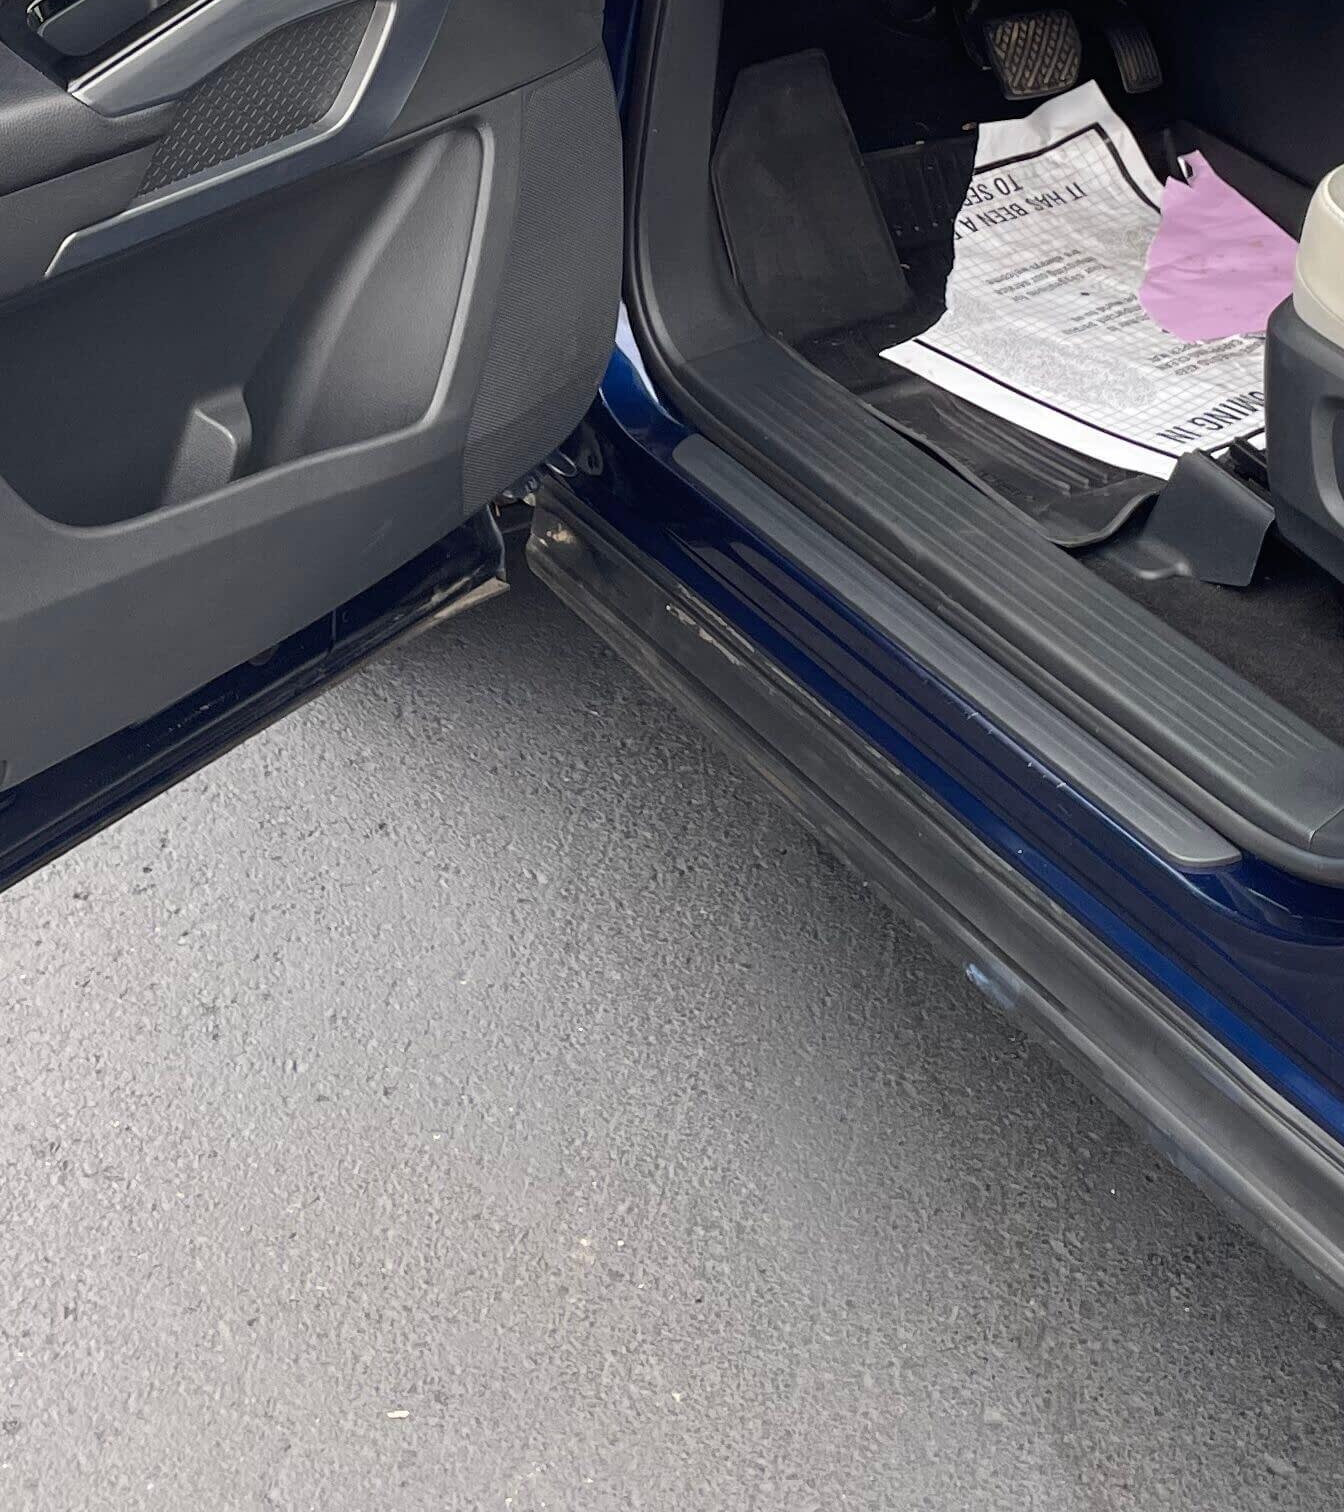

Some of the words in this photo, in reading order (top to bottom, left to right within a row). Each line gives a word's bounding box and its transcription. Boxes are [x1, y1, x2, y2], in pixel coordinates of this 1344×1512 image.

[993, 173, 1024, 196] TO
[1025, 190, 1067, 211] HAS
[976, 203, 1029, 226] BEEN
